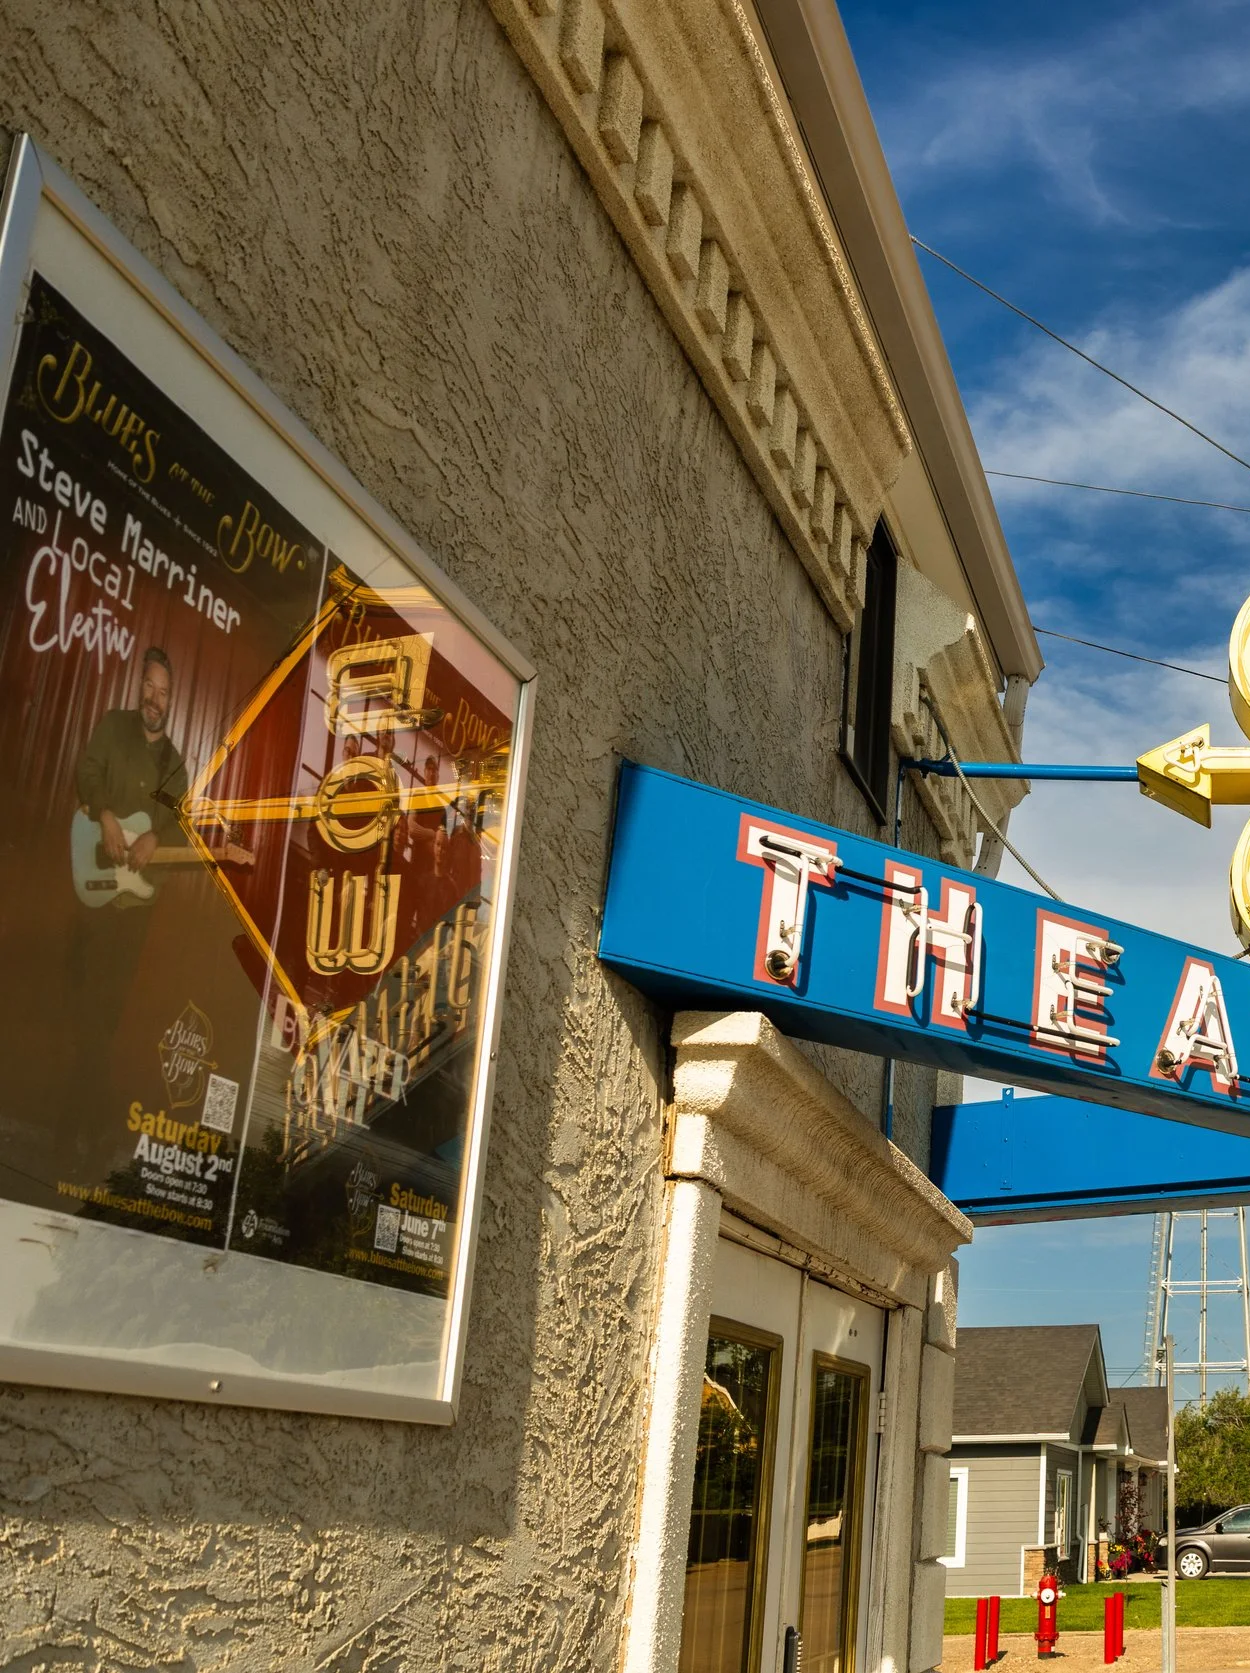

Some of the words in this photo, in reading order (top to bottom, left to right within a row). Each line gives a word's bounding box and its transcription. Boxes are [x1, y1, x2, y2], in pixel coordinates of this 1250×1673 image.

[12, 496, 48, 536] AND
[52, 510, 137, 611] Local
[17, 428, 108, 535] Steve
[121, 512, 241, 634] Marriner
[26, 545, 136, 675] Electric
[127, 1101, 222, 1155] Saturday
[132, 1133, 205, 1179] August
[204, 1154, 233, 1181] 2nd
[141, 1166, 164, 1183] Doors
[165, 1176, 184, 1189] open
[184, 1180, 192, 1191] at
[192, 1181, 208, 1195] 7:30
[57, 1180, 213, 1231] www.bluesatthebow.com
[145, 1182, 166, 1199] Show
[167, 1190, 188, 1204] starts
[188, 1196, 196, 1206] at
[389, 1182, 448, 1221] Saturday
[401, 1209, 430, 1238] June
[431, 1218, 447, 1240] 7th
